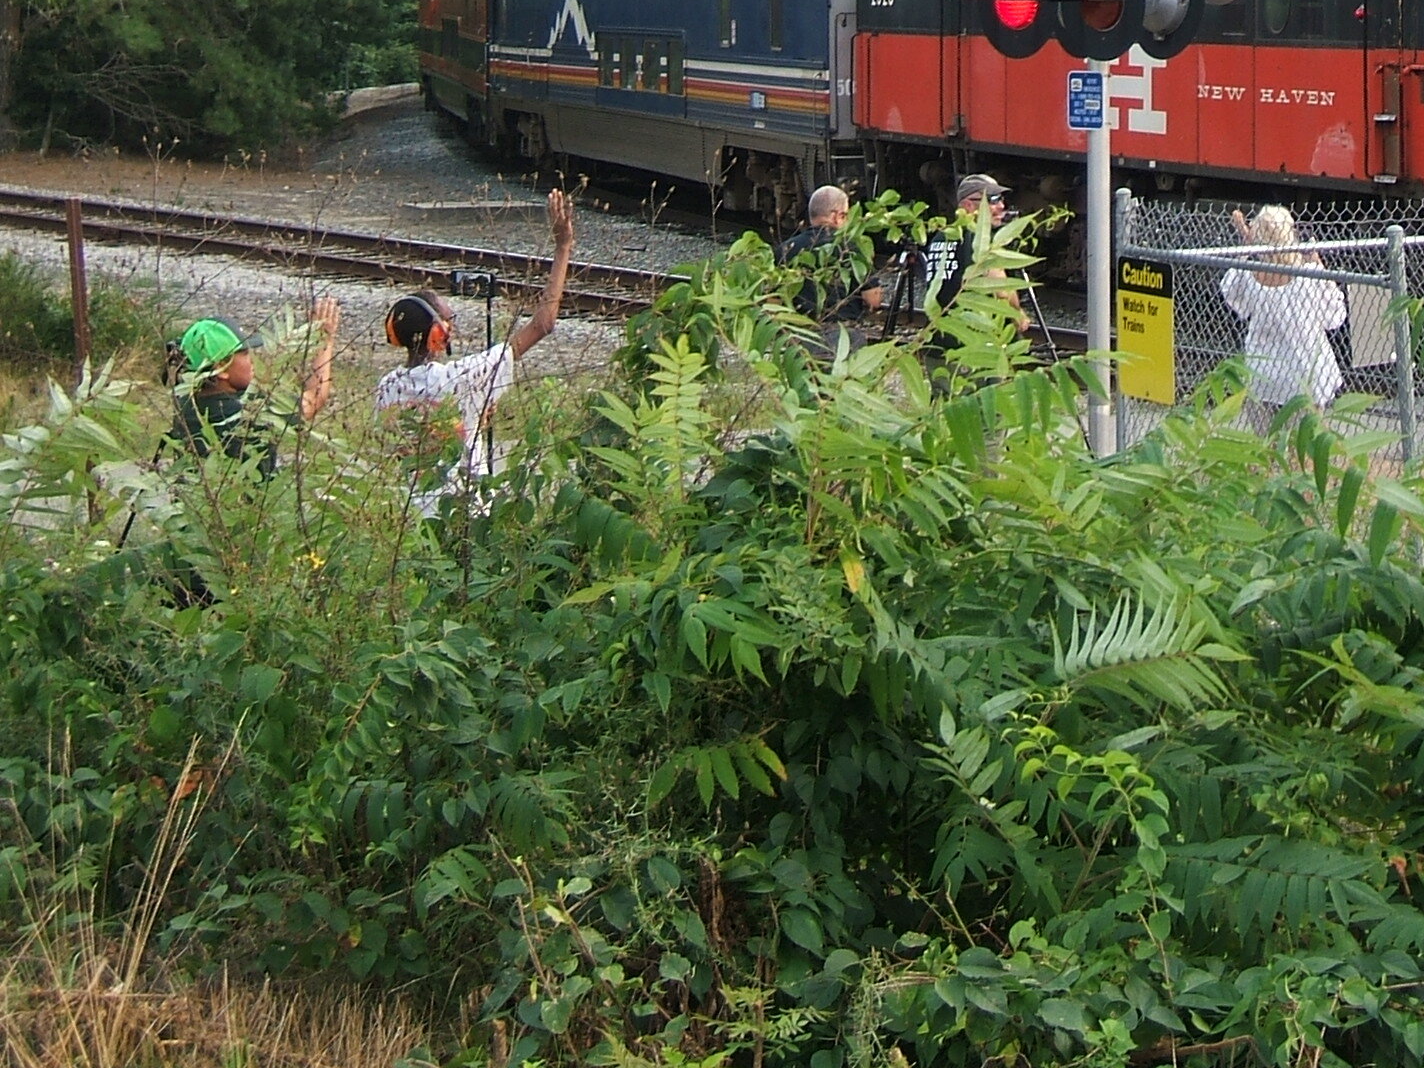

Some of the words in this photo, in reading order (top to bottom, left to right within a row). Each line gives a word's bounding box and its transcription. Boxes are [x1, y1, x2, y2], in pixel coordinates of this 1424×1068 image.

[1197, 84, 1246, 101] NEW
[1260, 89, 1336, 106] HAVEN
[1122, 262, 1164, 290] Caution
[1122, 297, 1145, 314] Watch
[1147, 301, 1159, 316] for
[1122, 316, 1145, 333] Trains
